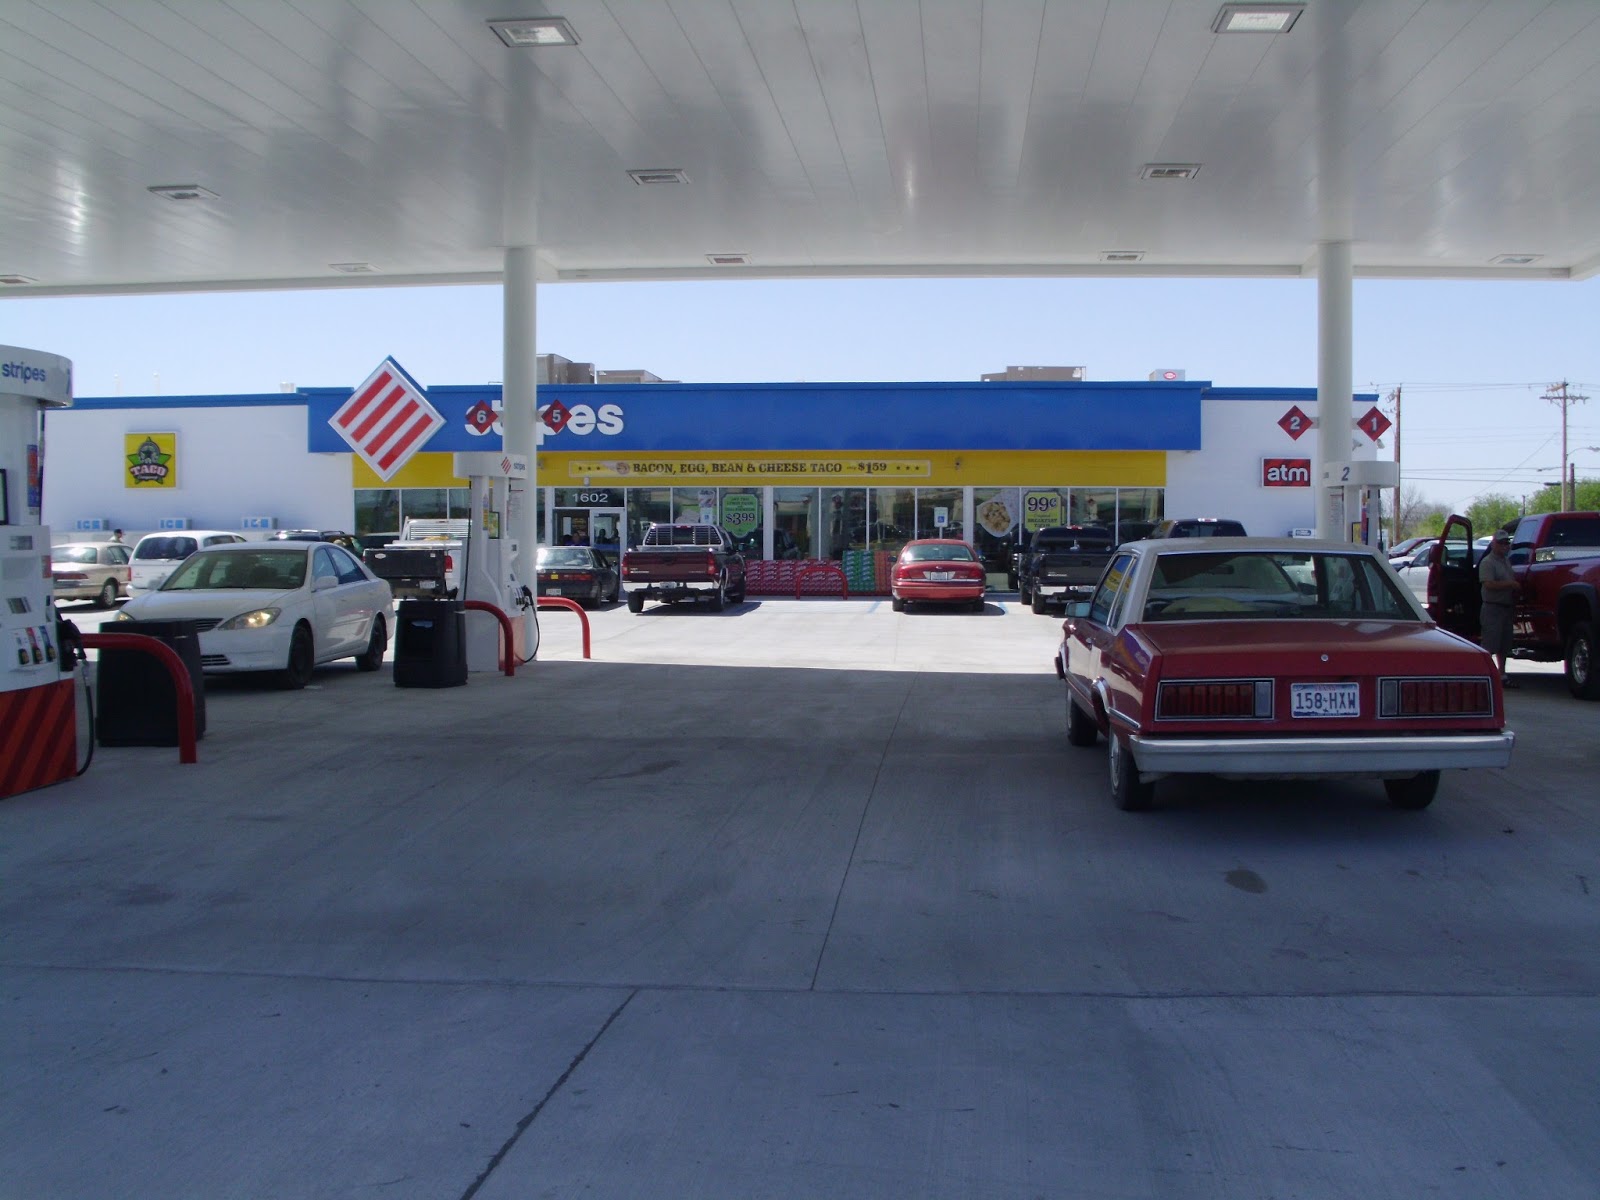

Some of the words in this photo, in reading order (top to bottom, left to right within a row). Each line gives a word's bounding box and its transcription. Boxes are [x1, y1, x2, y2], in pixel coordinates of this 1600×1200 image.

[2, 361, 46, 384] stripes
[476, 410, 487, 424] 6
[552, 410, 562, 423] 5
[1290, 416, 1301, 430] 2
[1371, 417, 1378, 432] 1
[130, 464, 167, 476] TACO
[633, 463, 676, 475] BACON,
[680, 463, 708, 475] EGG,
[712, 463, 743, 473] BEAN
[747, 463, 756, 473] &
[759, 463, 807, 473] CHEESE
[810, 463, 842, 473] TACO
[1267, 464, 1308, 481] atm
[1341, 466, 1350, 481] 2
[572, 493, 608, 503] 1602
